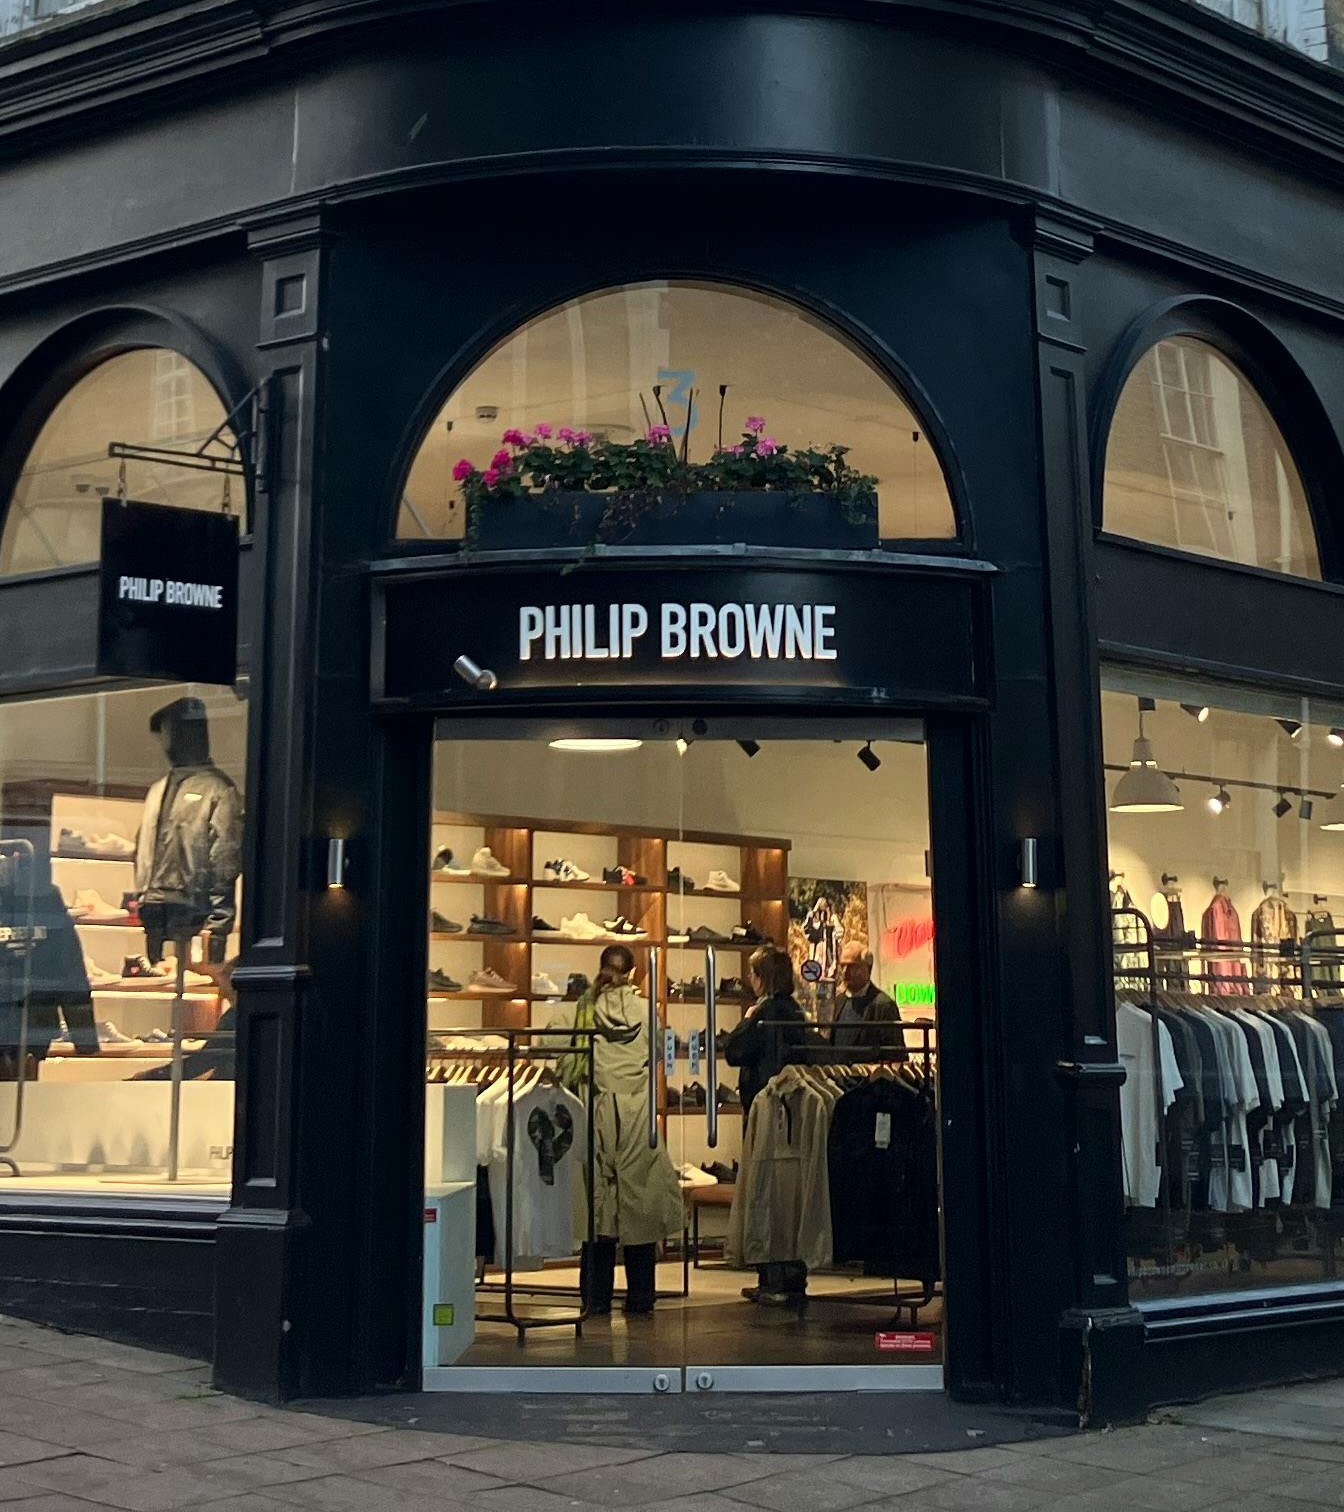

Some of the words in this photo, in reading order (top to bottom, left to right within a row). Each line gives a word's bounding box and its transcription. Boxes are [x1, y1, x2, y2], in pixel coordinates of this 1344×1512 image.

[119, 575, 164, 602] PHILIP
[166, 580, 224, 609] BROWNE
[519, 603, 648, 661] PHILIP
[661, 603, 838, 660] BROWNE
